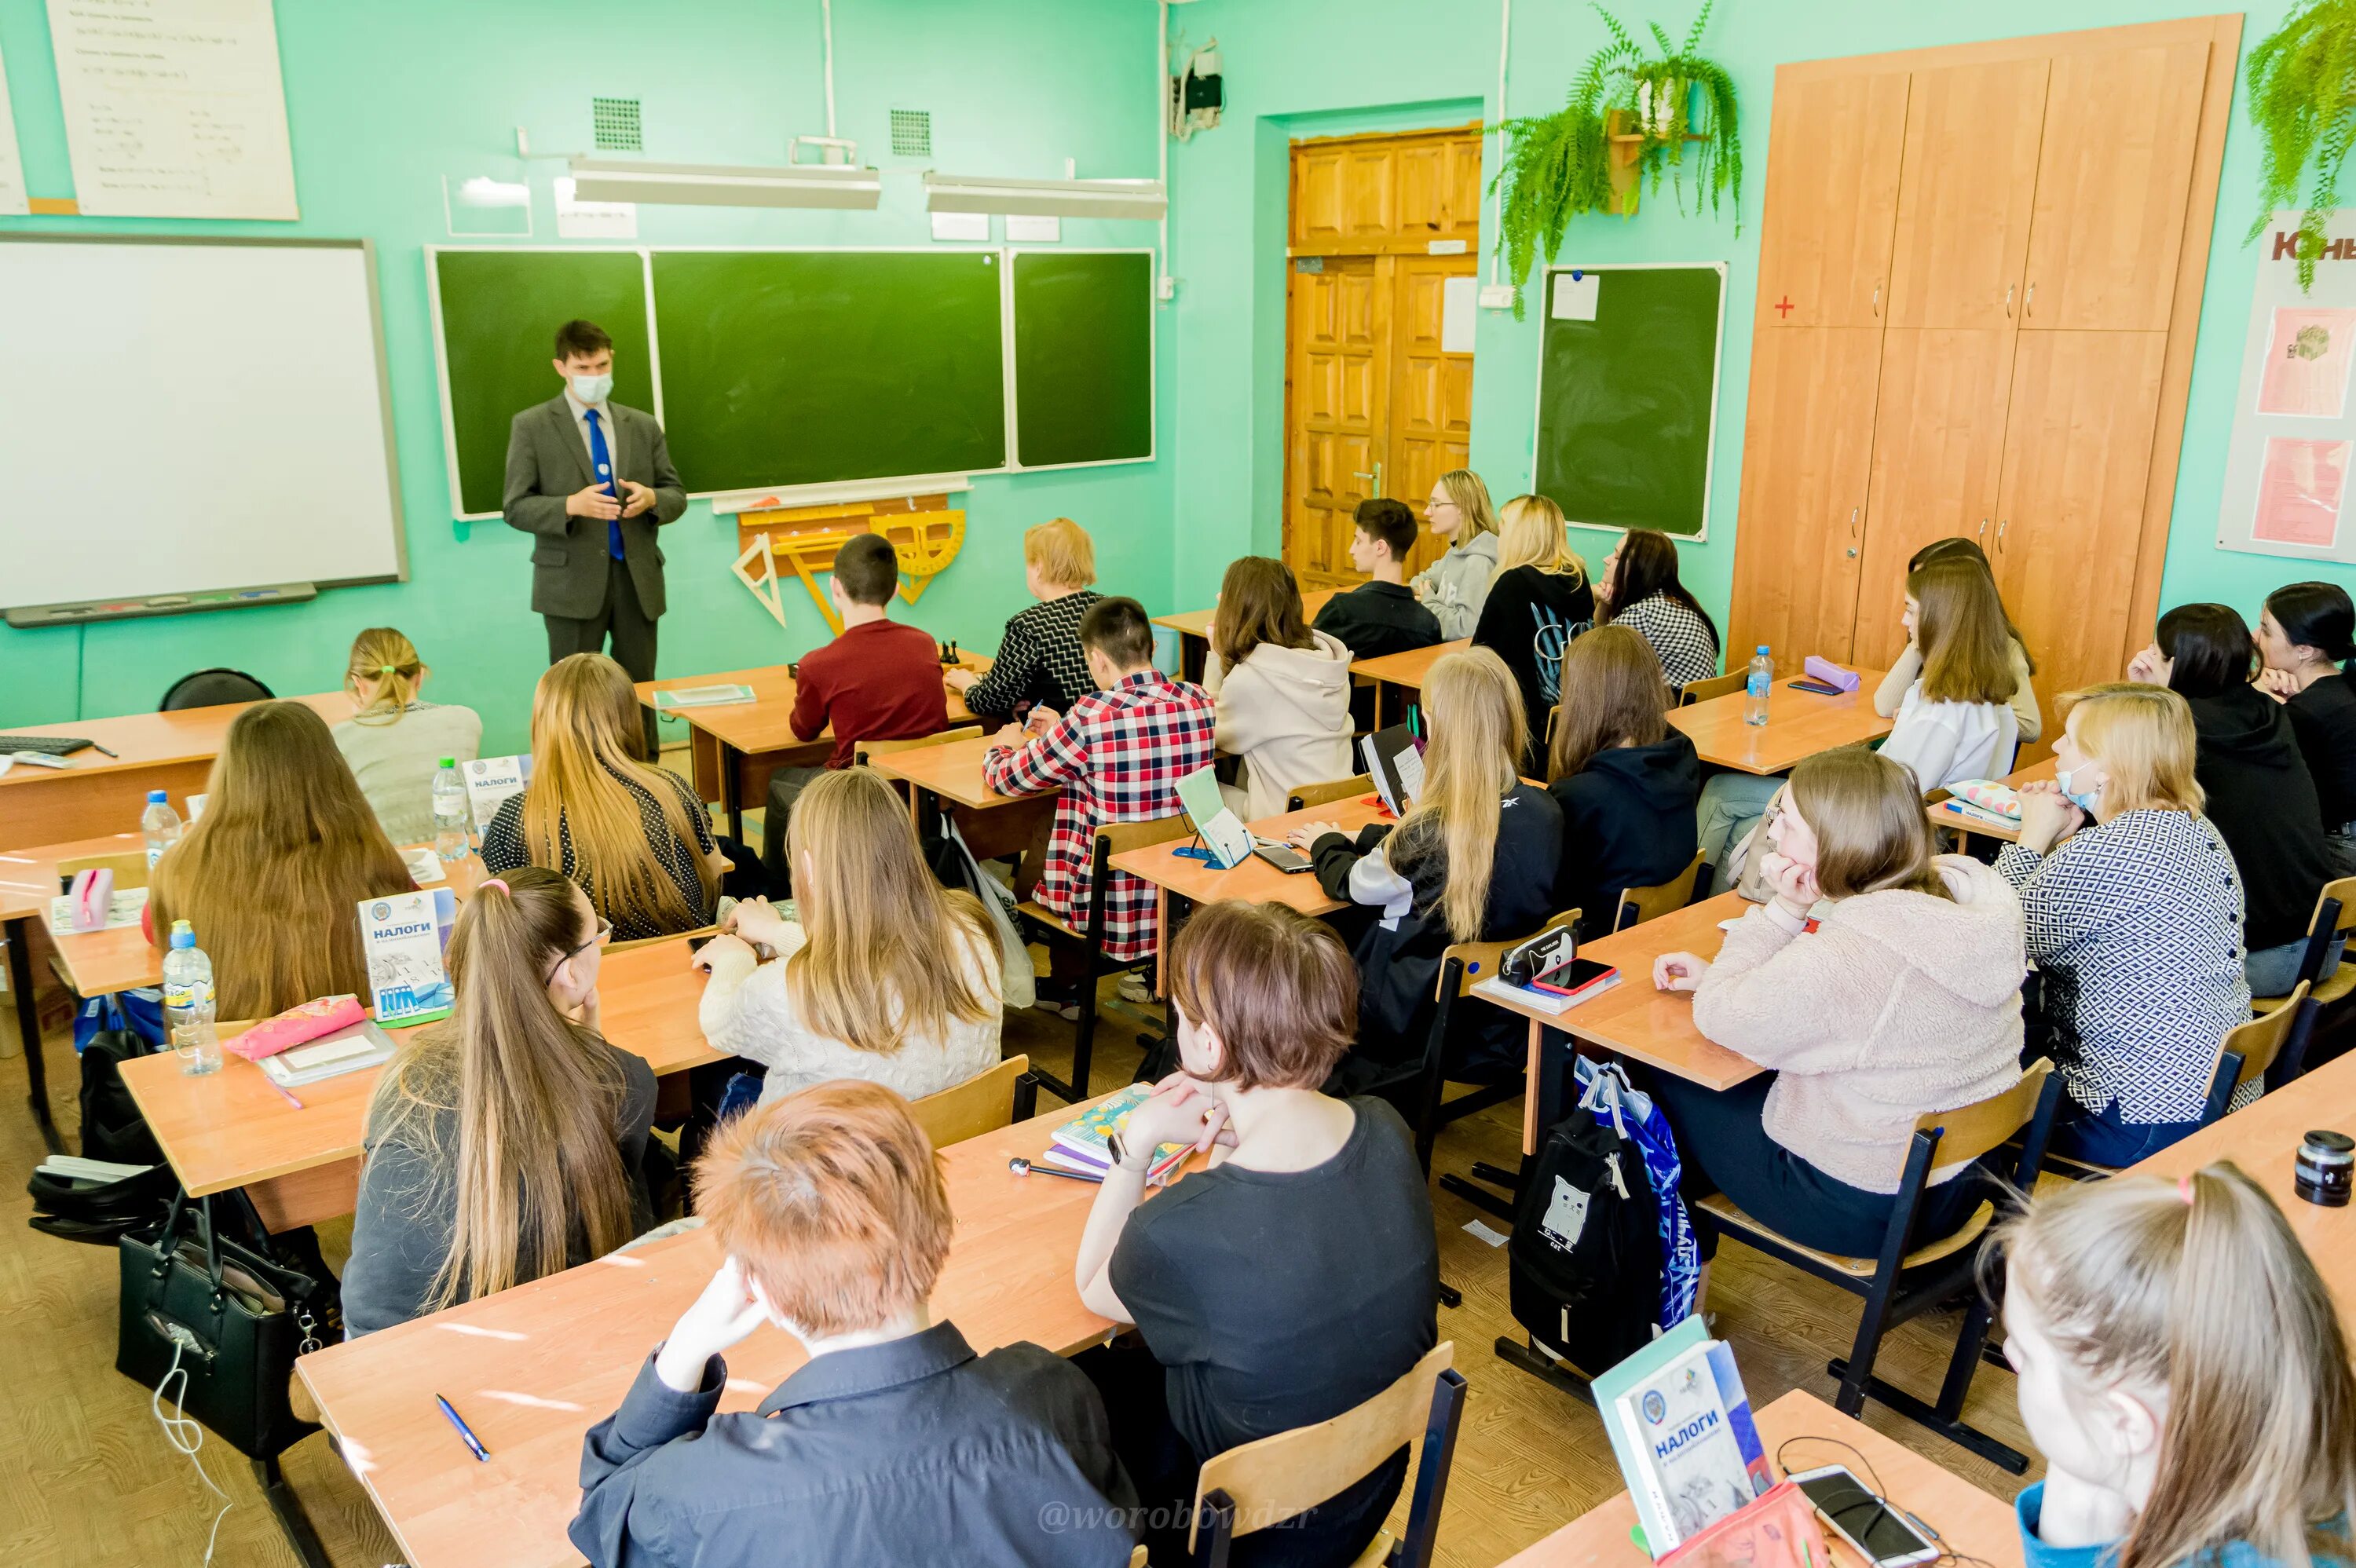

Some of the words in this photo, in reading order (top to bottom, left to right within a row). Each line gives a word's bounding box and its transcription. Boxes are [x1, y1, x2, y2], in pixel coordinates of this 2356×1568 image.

[474, 777, 517, 788] НАЛОГИ
[374, 923, 431, 939] НАЛОГИ
[1549, 1241, 1561, 1252] cat
[1655, 1409, 1719, 1459] НАЛОГИ
